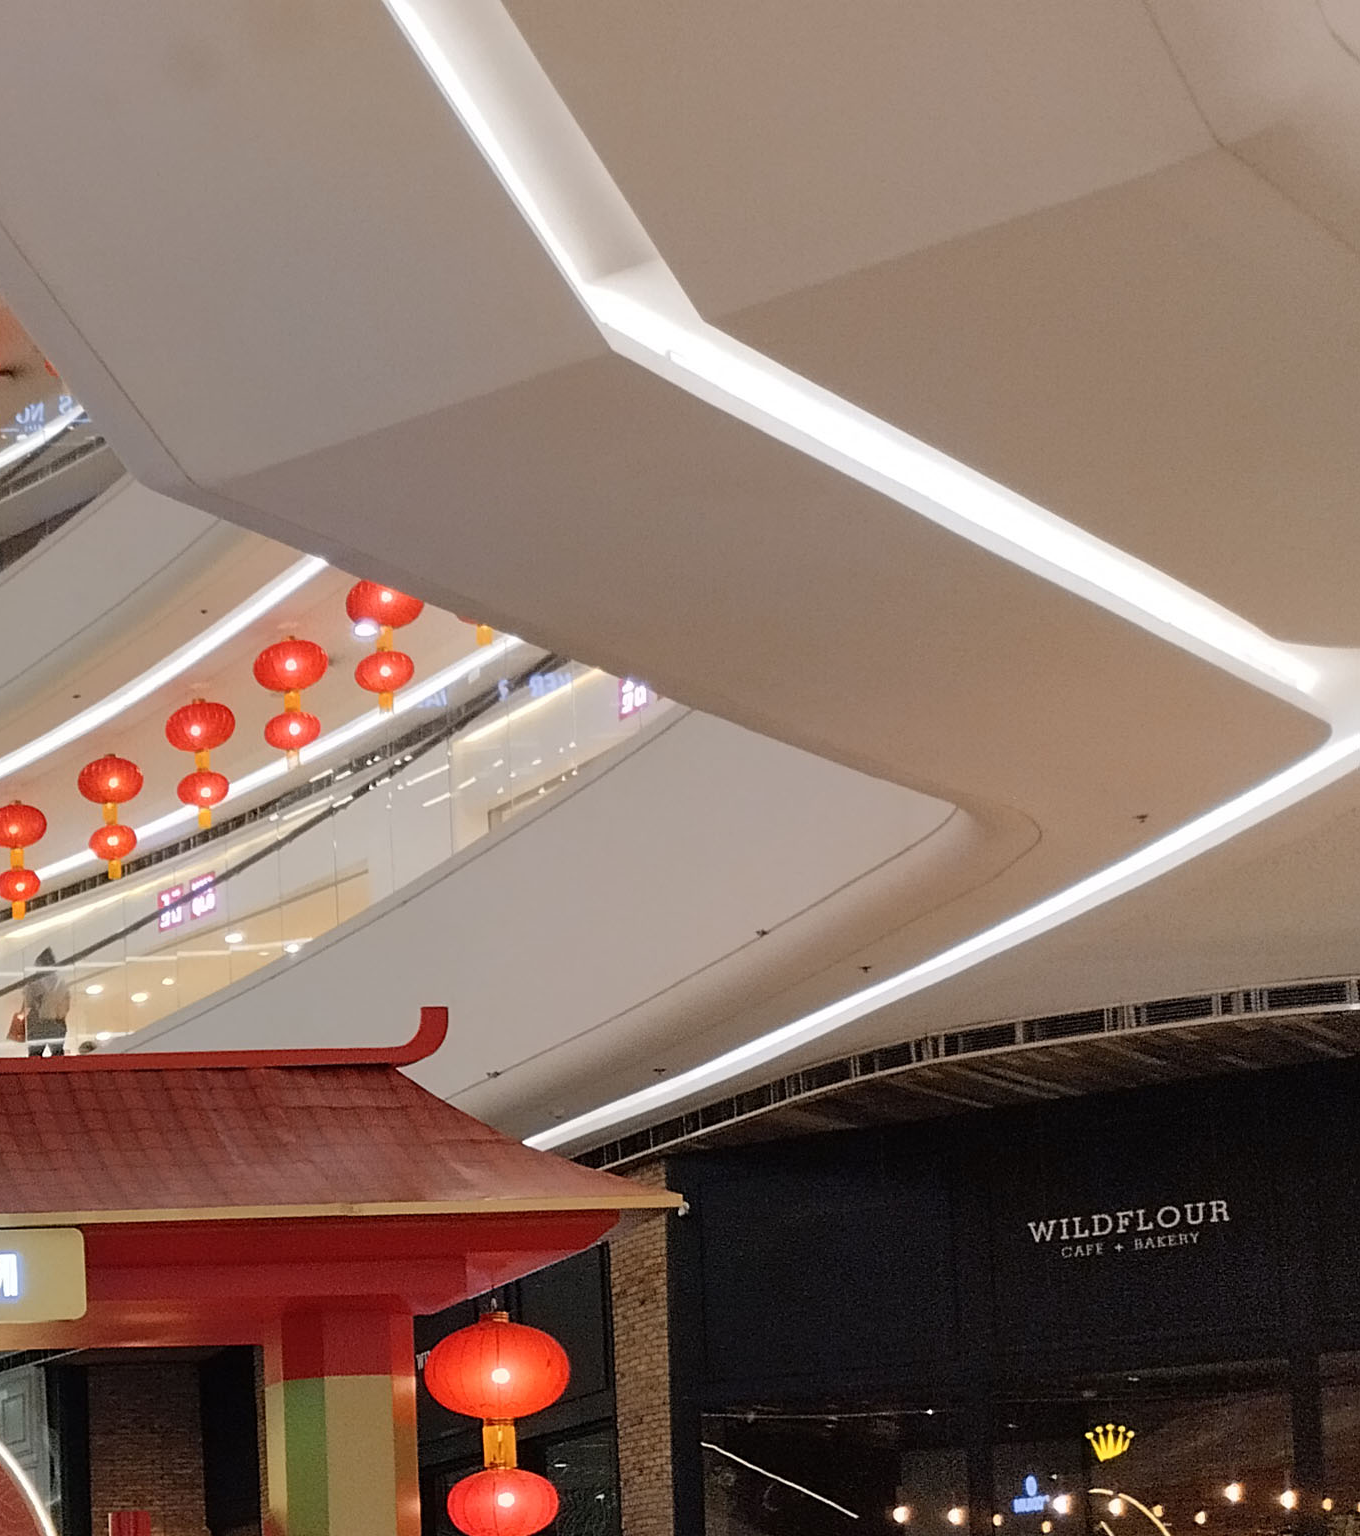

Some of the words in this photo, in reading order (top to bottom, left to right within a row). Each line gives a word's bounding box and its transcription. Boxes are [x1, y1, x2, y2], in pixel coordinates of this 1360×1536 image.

[1028, 1200, 1230, 1243] WILDFLOUR
[1061, 1243, 1104, 1258] CAFE
[1134, 1232, 1200, 1250] BAKERY
